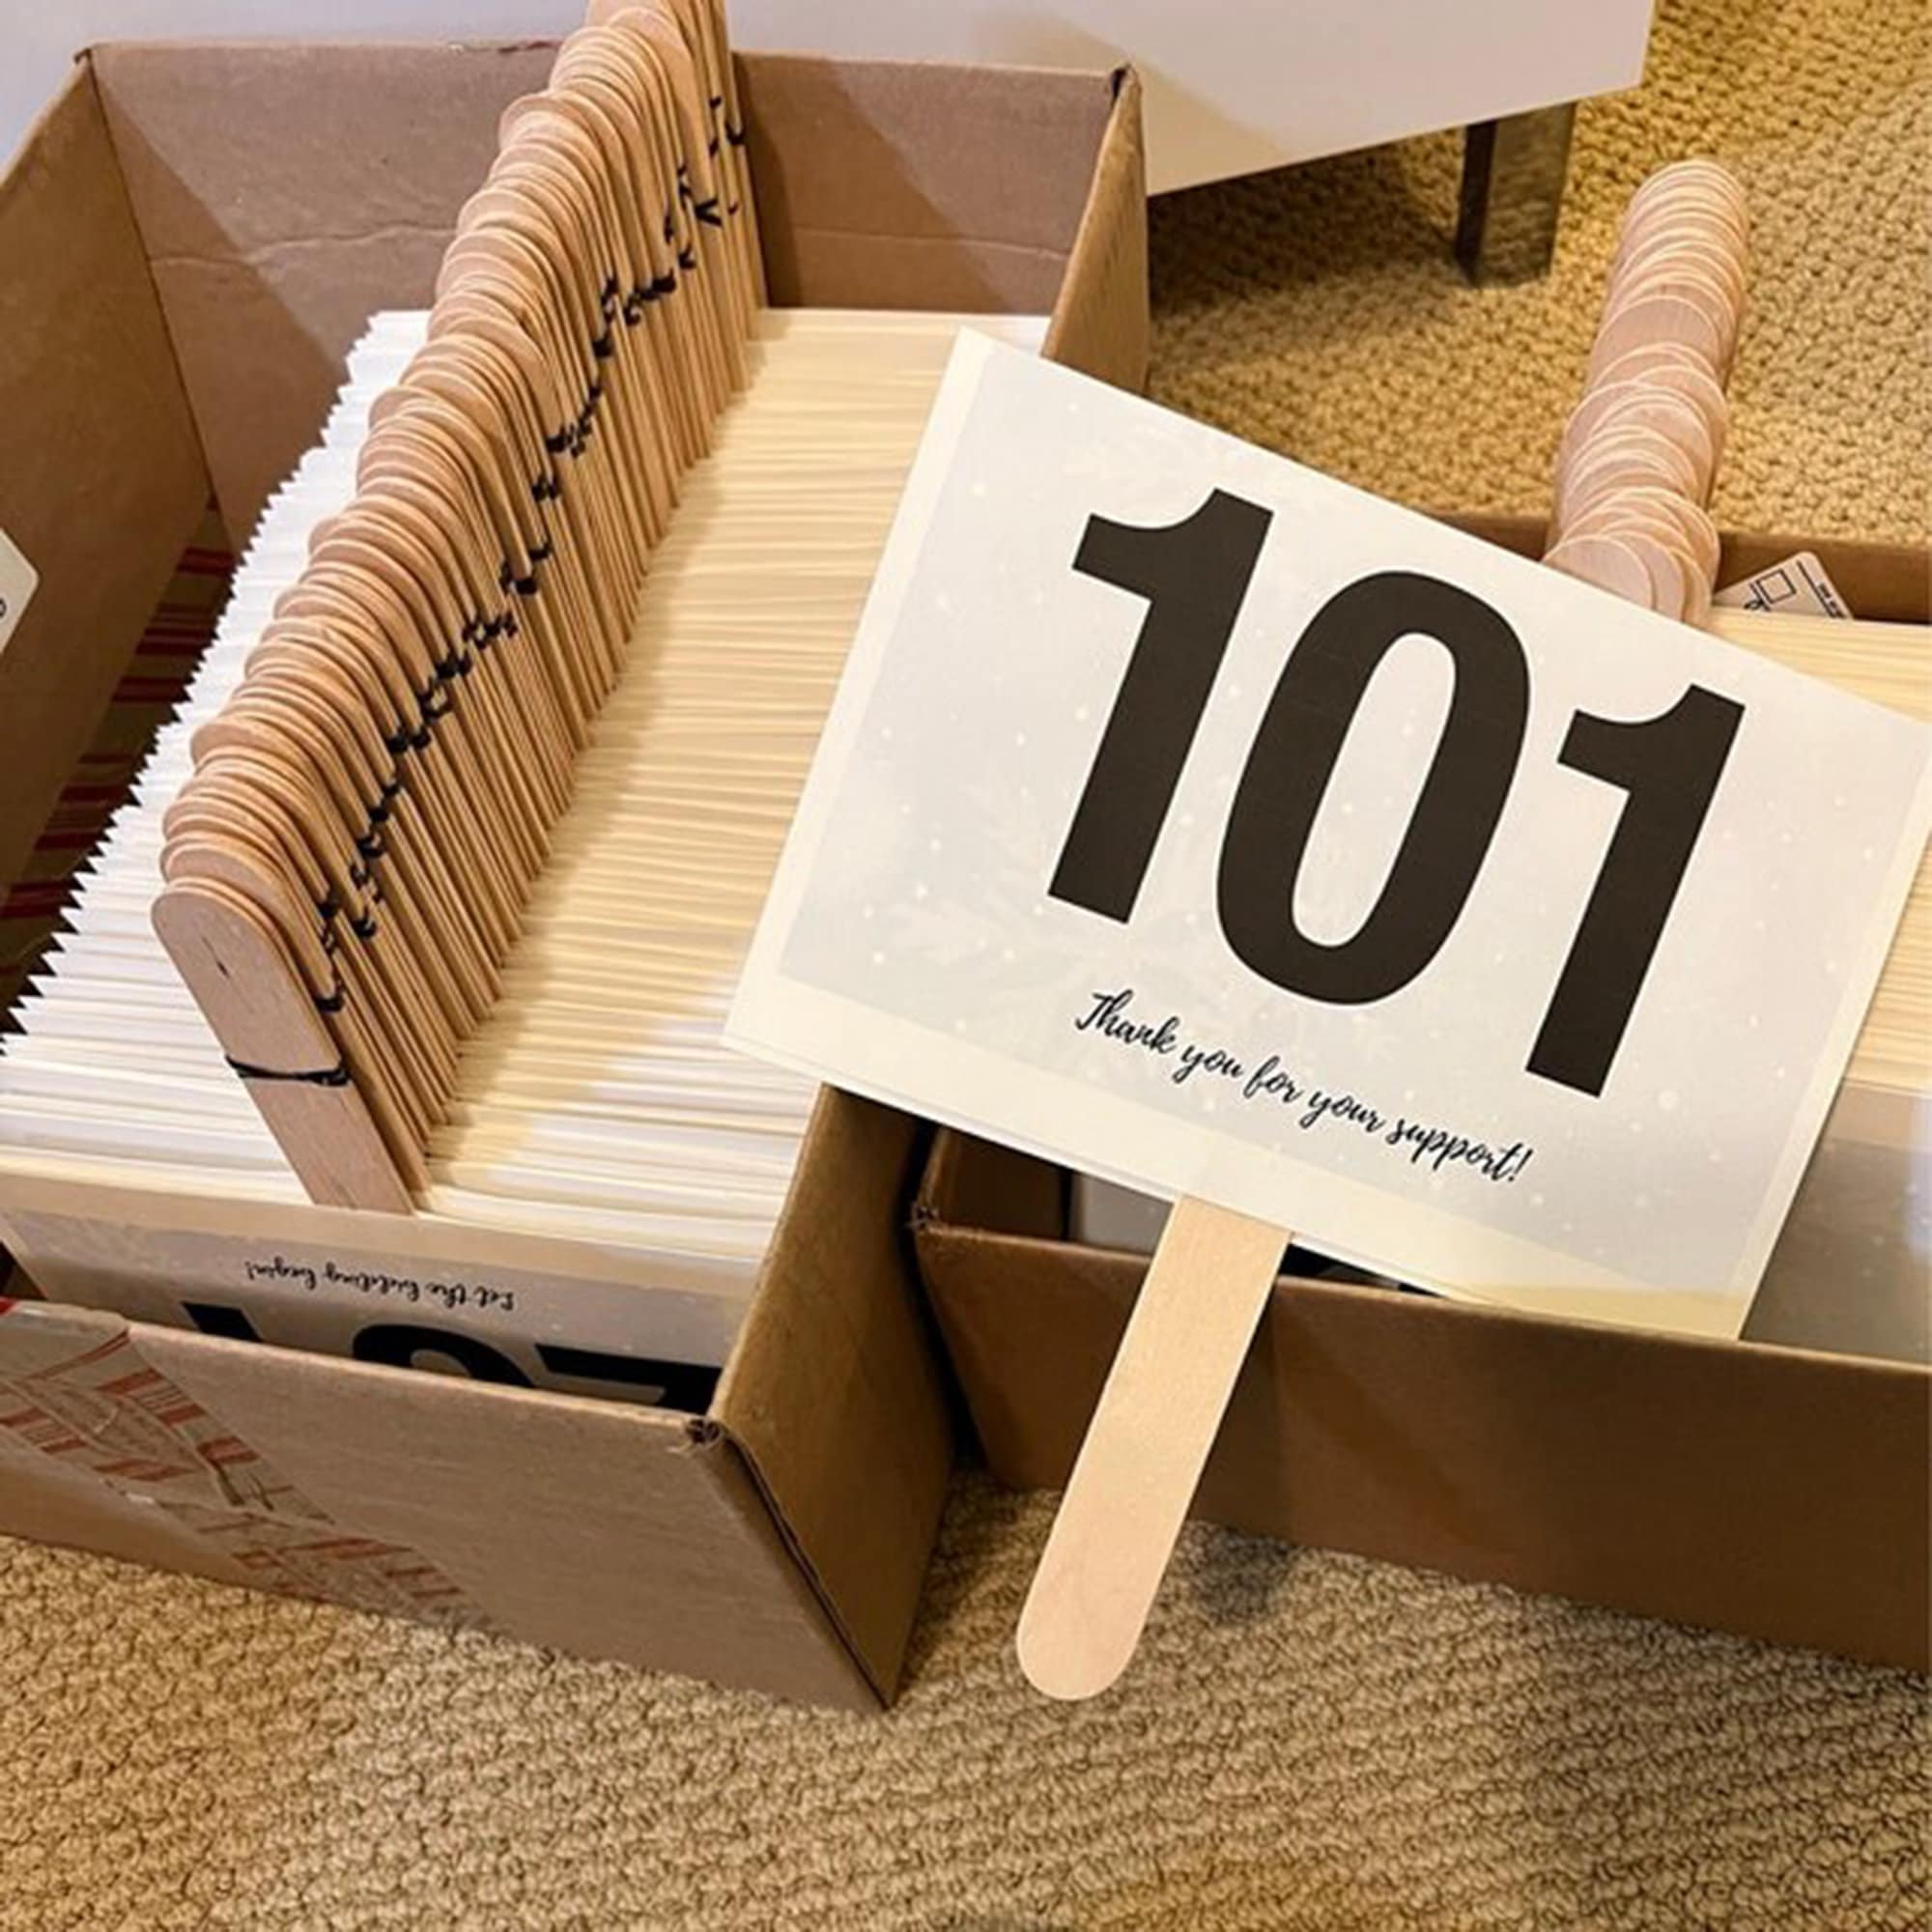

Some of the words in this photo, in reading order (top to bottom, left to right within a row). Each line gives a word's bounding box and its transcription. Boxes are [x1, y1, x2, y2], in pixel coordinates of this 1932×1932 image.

[1047, 488, 1747, 1099] 101
[1074, 988, 1178, 1055] Thank
[1172, 1042, 1244, 1085] you
[1242, 1055, 1303, 1099] for
[1295, 1090, 1385, 1130] your
[1384, 1117, 1535, 1183] support!
[243, 1256, 317, 1291] begin!
[324, 1260, 420, 1303] bidding
[425, 1282, 467, 1309] the
[474, 1285, 515, 1312] Let
